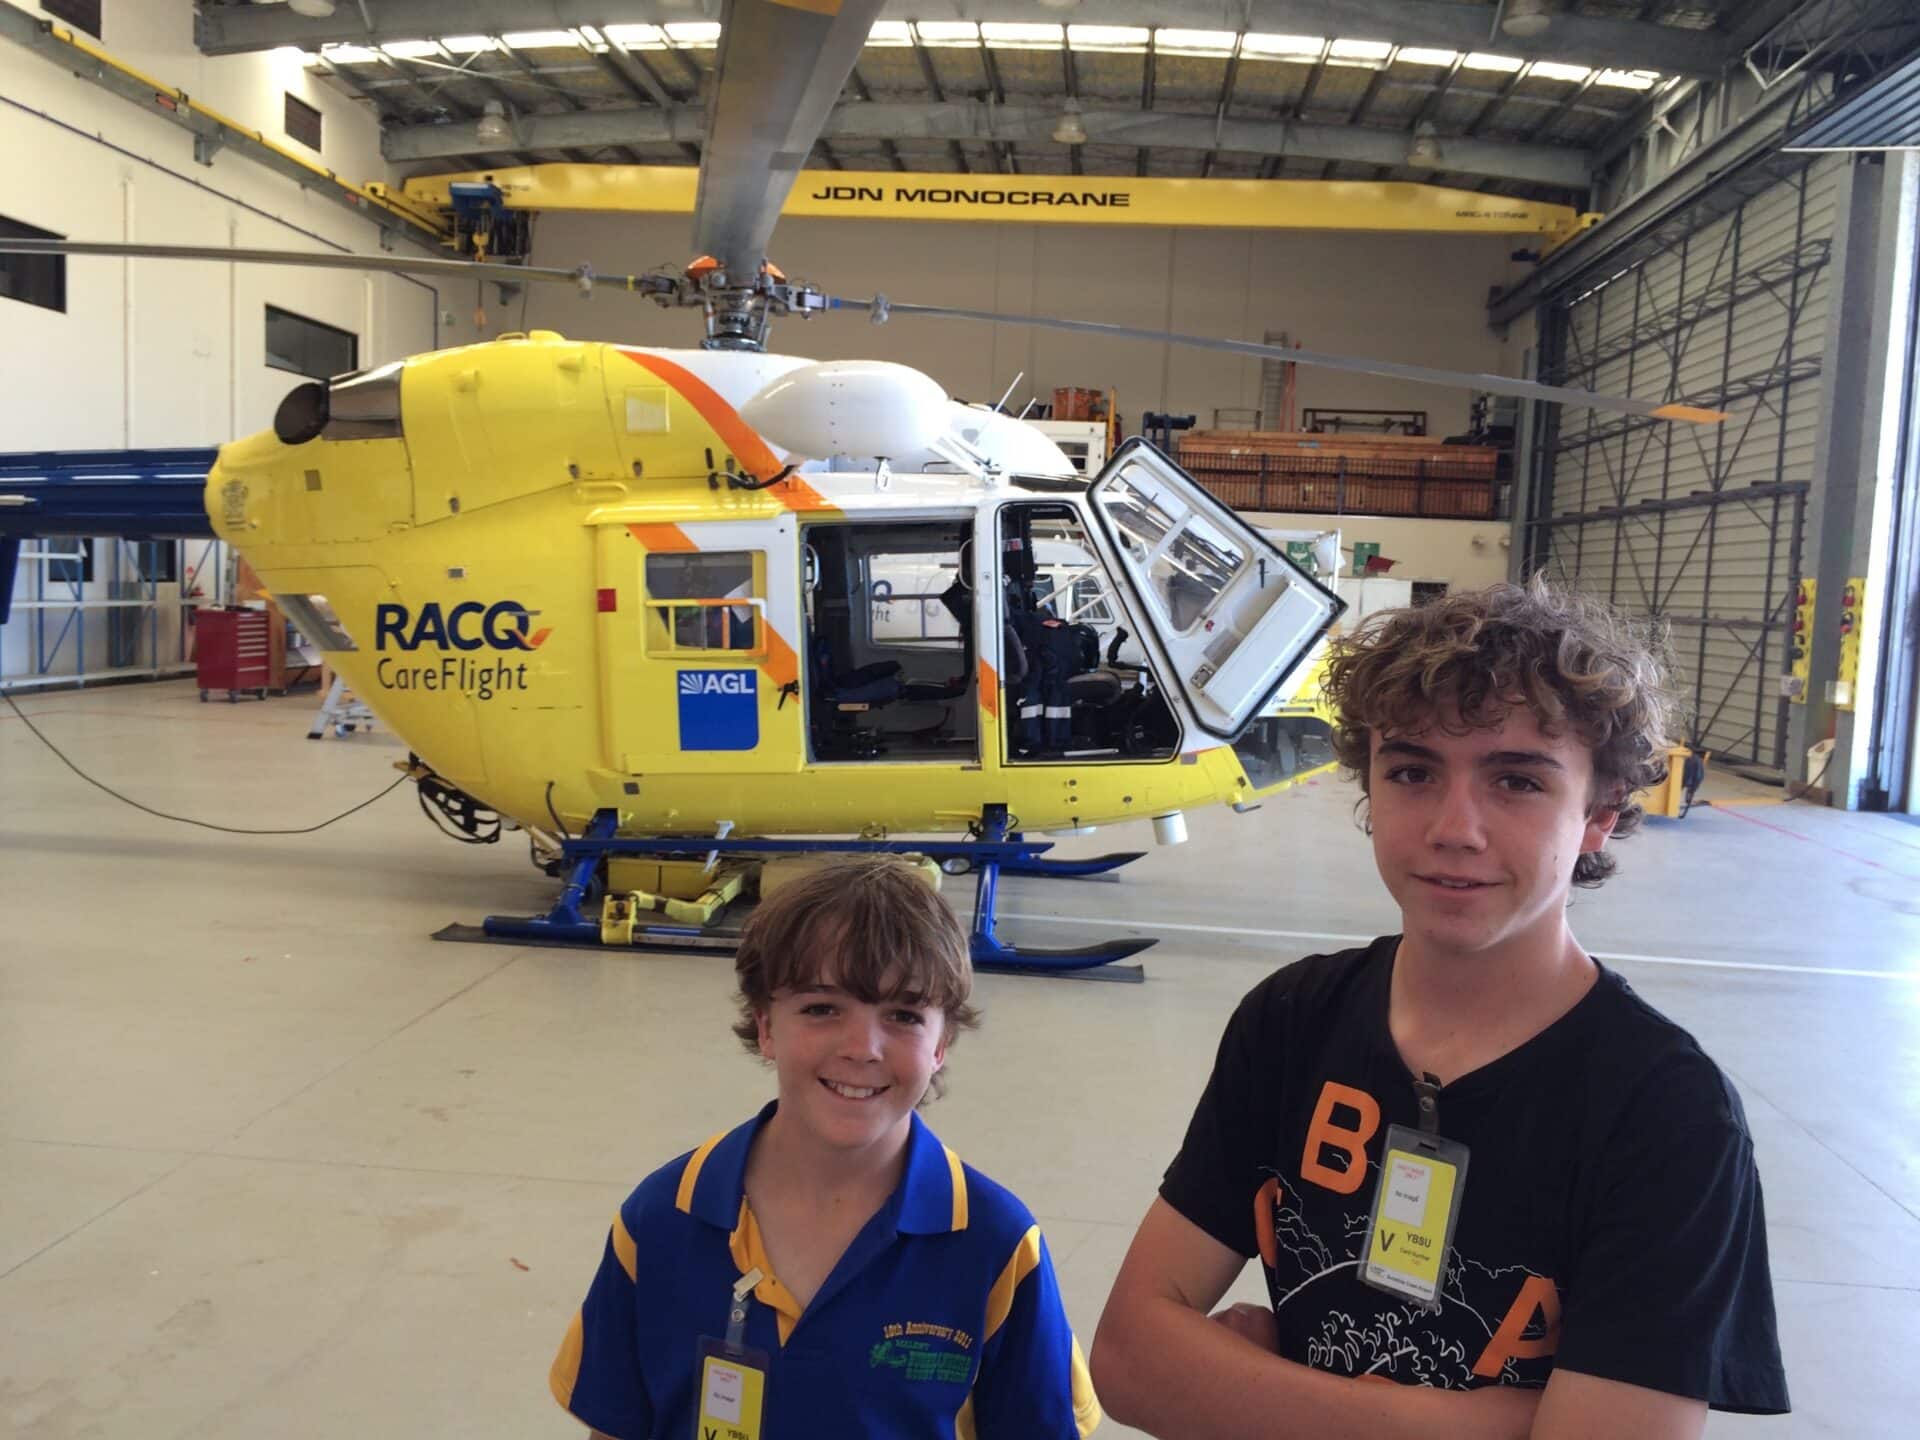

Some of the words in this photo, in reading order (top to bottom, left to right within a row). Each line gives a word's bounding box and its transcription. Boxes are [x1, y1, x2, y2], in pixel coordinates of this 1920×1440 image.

[813, 187, 883, 201] JDN
[895, 188, 1131, 208] MONOCRANE
[376, 601, 541, 651] RACQ
[377, 657, 528, 701] CareFlight
[703, 673, 755, 695] AGL
[1300, 1080, 1381, 1195] B
[1380, 1229, 1396, 1252] V
[1406, 1231, 1433, 1248] YBSU
[905, 1321, 954, 1341] Anniversary
